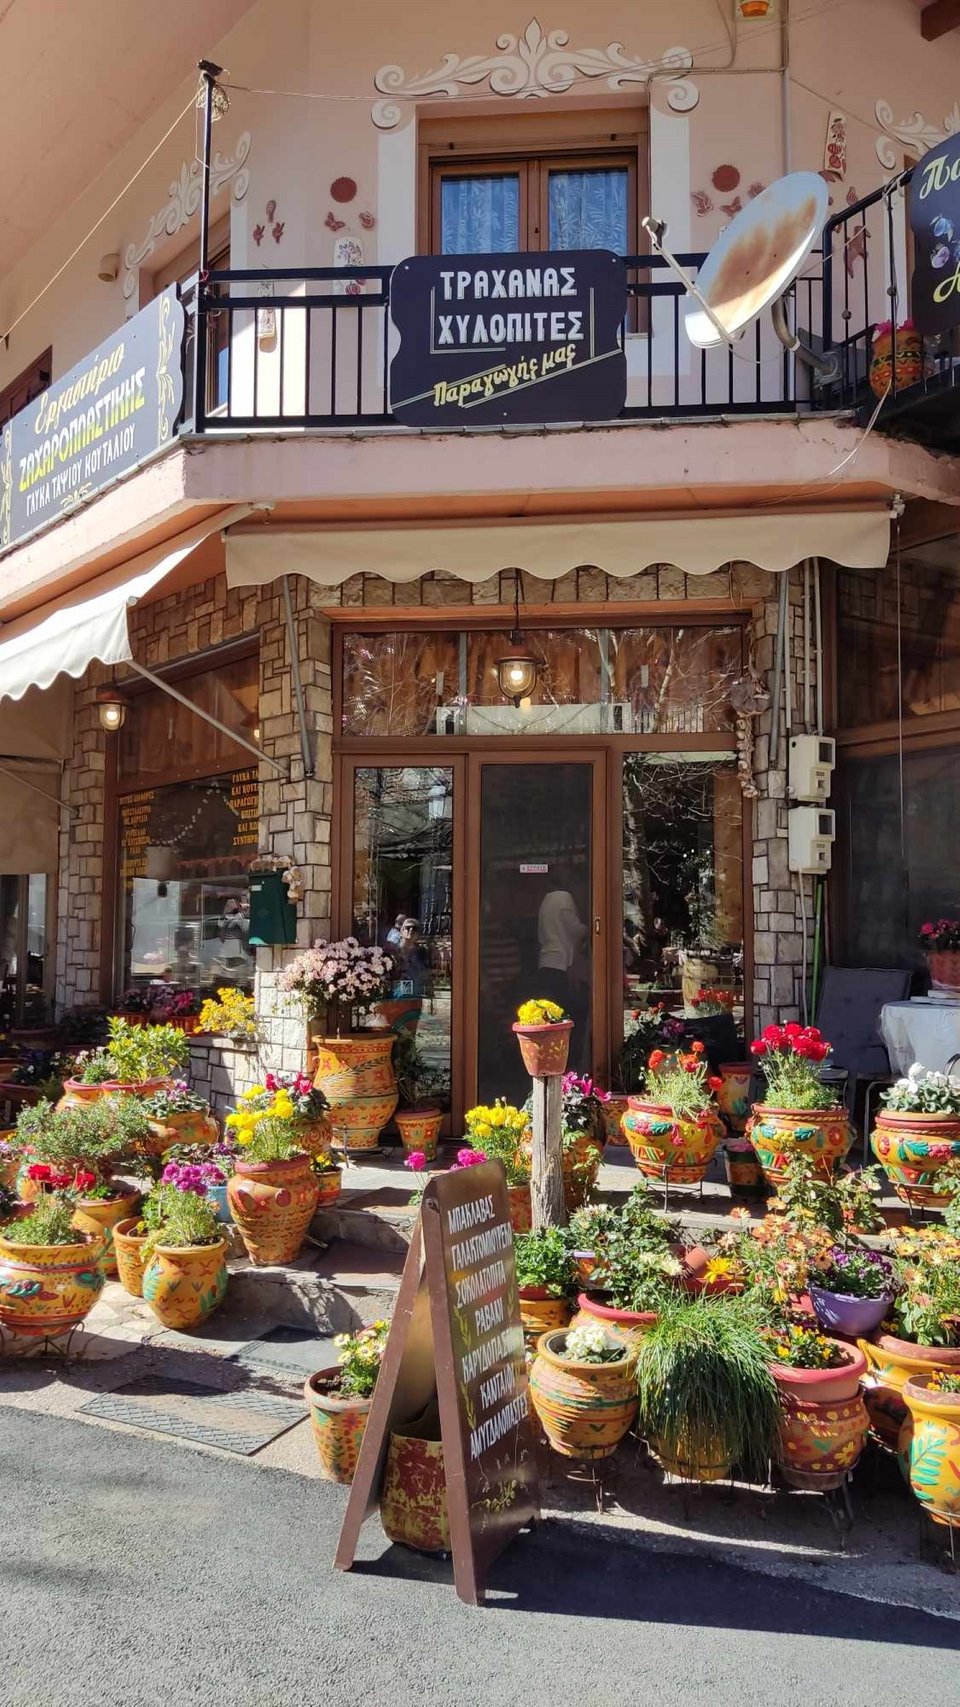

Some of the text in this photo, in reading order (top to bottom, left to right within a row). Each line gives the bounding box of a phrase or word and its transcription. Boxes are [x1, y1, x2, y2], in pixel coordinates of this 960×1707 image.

[440, 267, 577, 301] ΤΡΑΧΑΝΑΣ
[438, 310, 584, 345] ΧΥΛΟΠΙΤΕΣ
[35, 342, 125, 436] Εργαστήριο
[433, 343, 577, 407] Παραγωγής μας
[26, 422, 136, 517] ΓΛΥΚΑ ΤΑΨΙΟΥ ΚΟΥΤΑΛΙΟΥ
[447, 1194, 496, 1235] ΜΠΑΚΛΑΒΑΣ
[455, 1260, 507, 1309] ΣΟΚΟΛΑΤΟΠΙΤΑ
[475, 1298, 504, 1337] ΡΑΒΑΝΙ
[461, 1325, 518, 1384] ΚΑΡΥΔΟΠΑΣΤ
[479, 1362, 515, 1411] ΚΑΝΤΑΙΦΙ
[470, 1391, 529, 1462] ΑΜΥΓΔΑΛΟΠΑΣΤΕΣ
